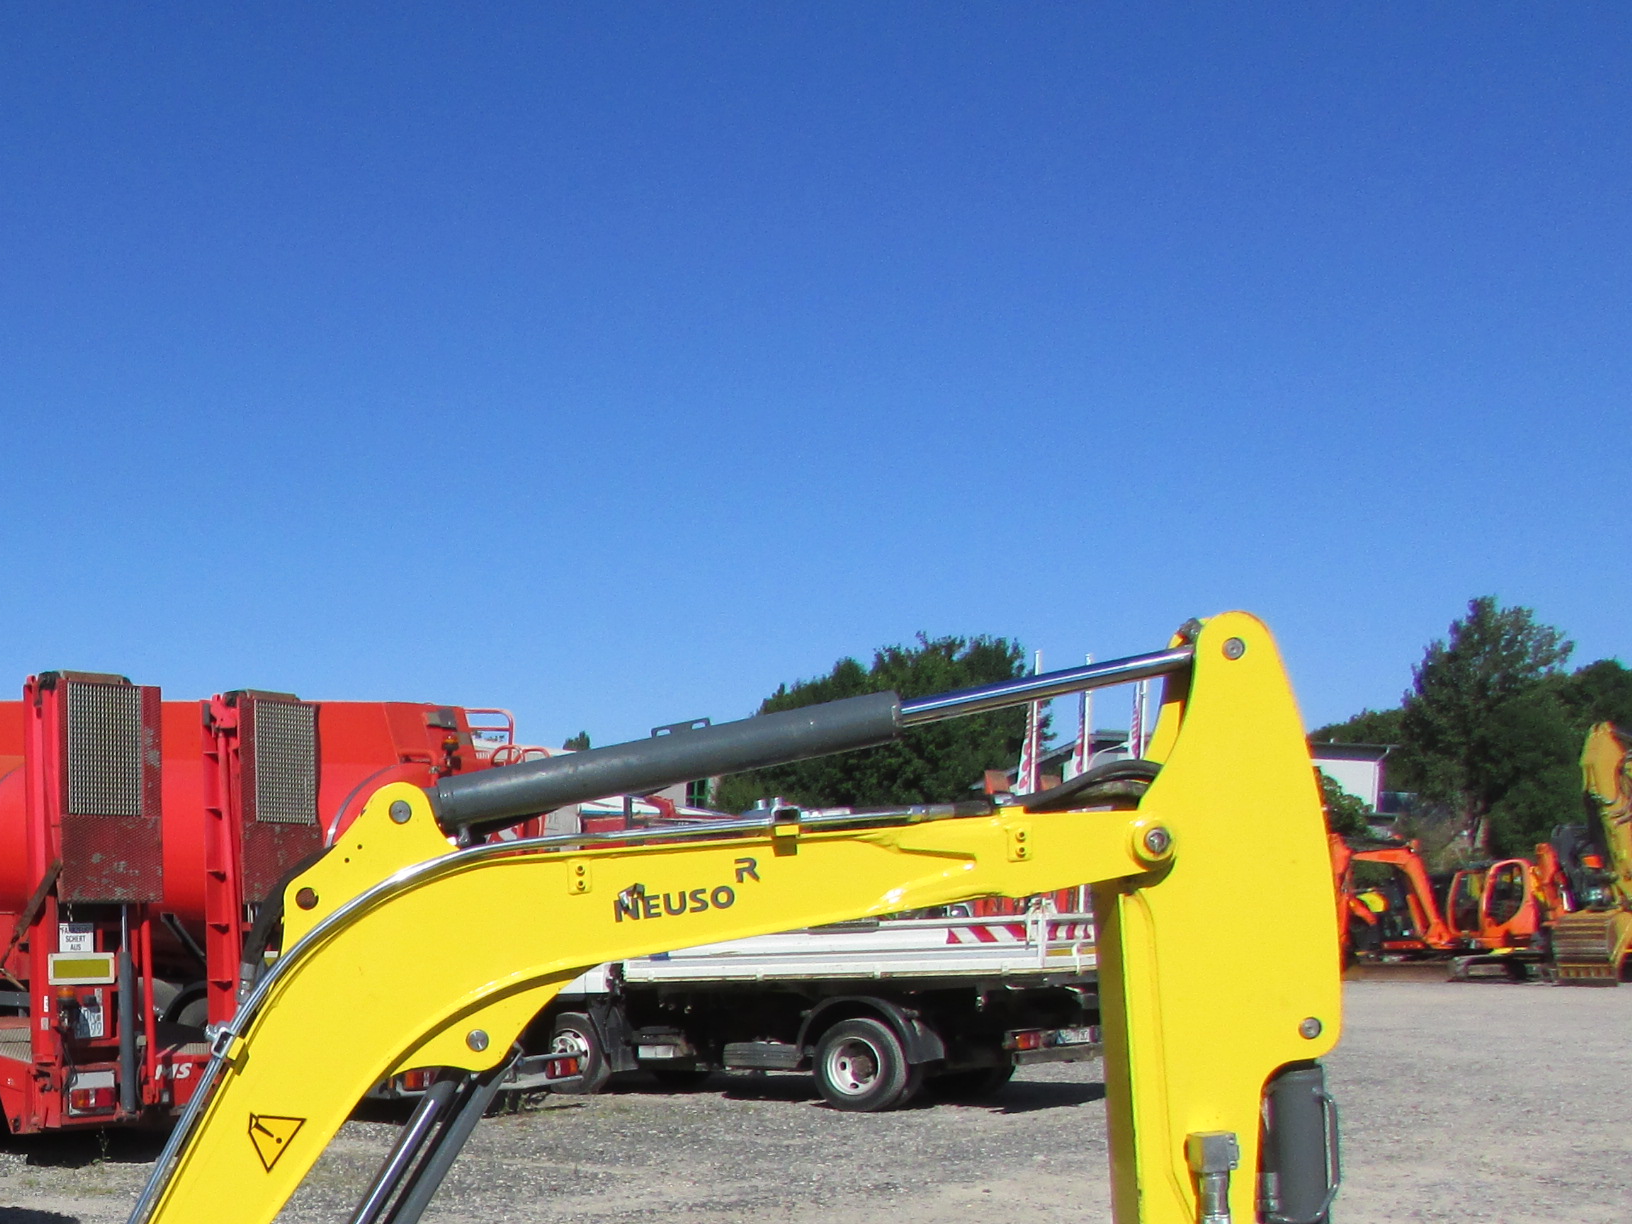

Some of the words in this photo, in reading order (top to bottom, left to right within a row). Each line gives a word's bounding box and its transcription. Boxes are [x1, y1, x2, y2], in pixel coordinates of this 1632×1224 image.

[613, 885, 735, 923] NEUSO
[65, 935, 86, 943] SCHERT
[70, 943, 82, 951] AUS
